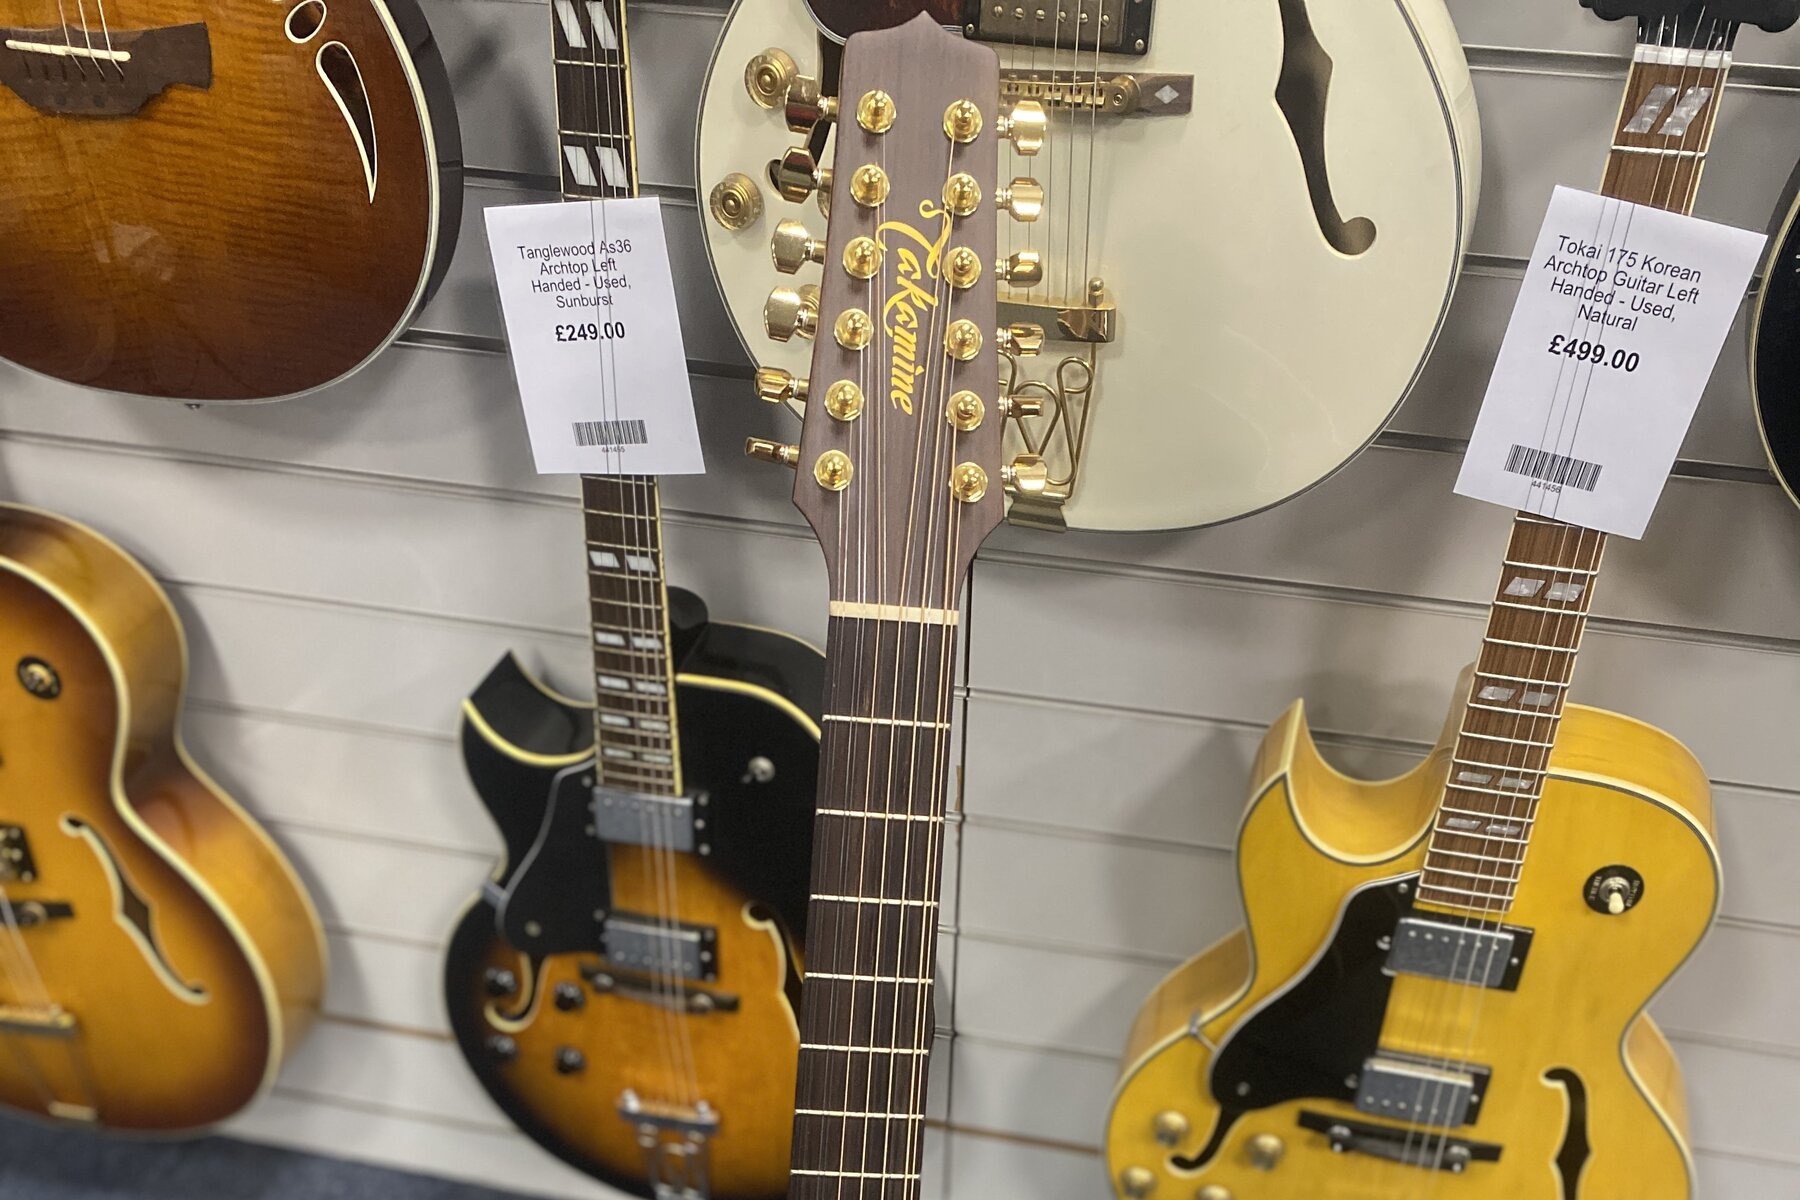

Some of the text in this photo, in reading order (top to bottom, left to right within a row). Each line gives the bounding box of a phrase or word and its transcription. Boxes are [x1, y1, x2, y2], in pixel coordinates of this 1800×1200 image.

[517, 239, 632, 261] Tanglewood As36
[1558, 234, 1702, 283] Tokai 175 Korean
[540, 257, 617, 276] Archtop Left
[1543, 255, 1700, 304] Archtop Guitar Left
[531, 277, 581, 293] Handed
[593, 274, 632, 290] Used,
[555, 294, 614, 309] Sunburst
[875, 199, 951, 416] Takamine
[1550, 276, 1616, 305] Handed
[1630, 295, 1676, 323] Used,
[555, 321, 626, 342] £249.00
[1577, 304, 1639, 332] Natural
[1548, 334, 1640, 373] £499.00
